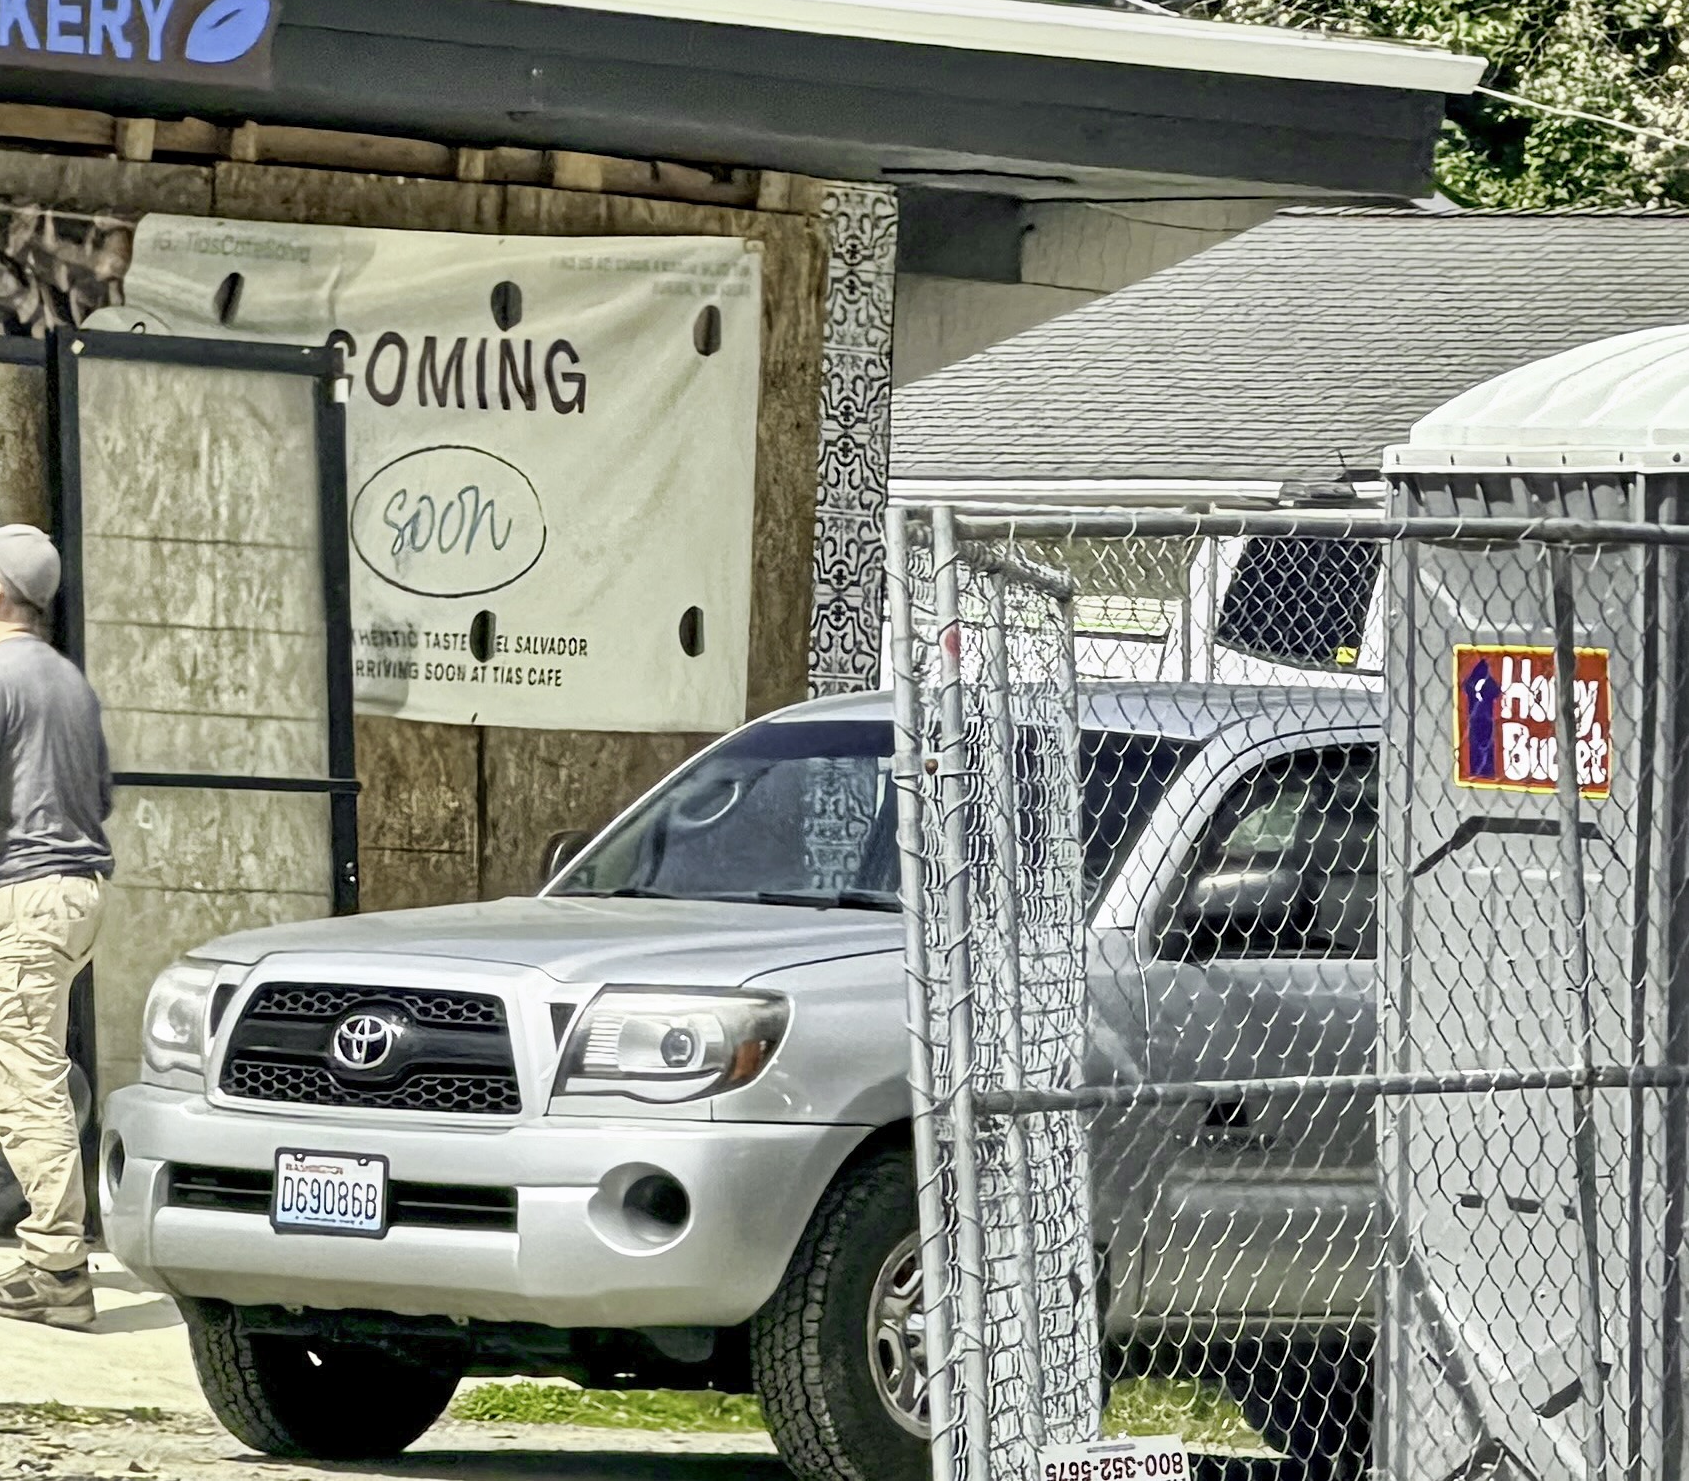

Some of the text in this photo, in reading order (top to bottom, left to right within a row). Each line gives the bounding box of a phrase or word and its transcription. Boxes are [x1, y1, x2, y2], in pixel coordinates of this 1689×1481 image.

[425, 631, 468, 651] TASTE
[496, 634, 510, 653] EL
[514, 635, 588, 656] SALVADOR
[354, 659, 563, 687] RRIVING SOON AT TIAS CAFE
[1501, 656, 1599, 738] Hoy
[1502, 722, 1608, 784] Buet
